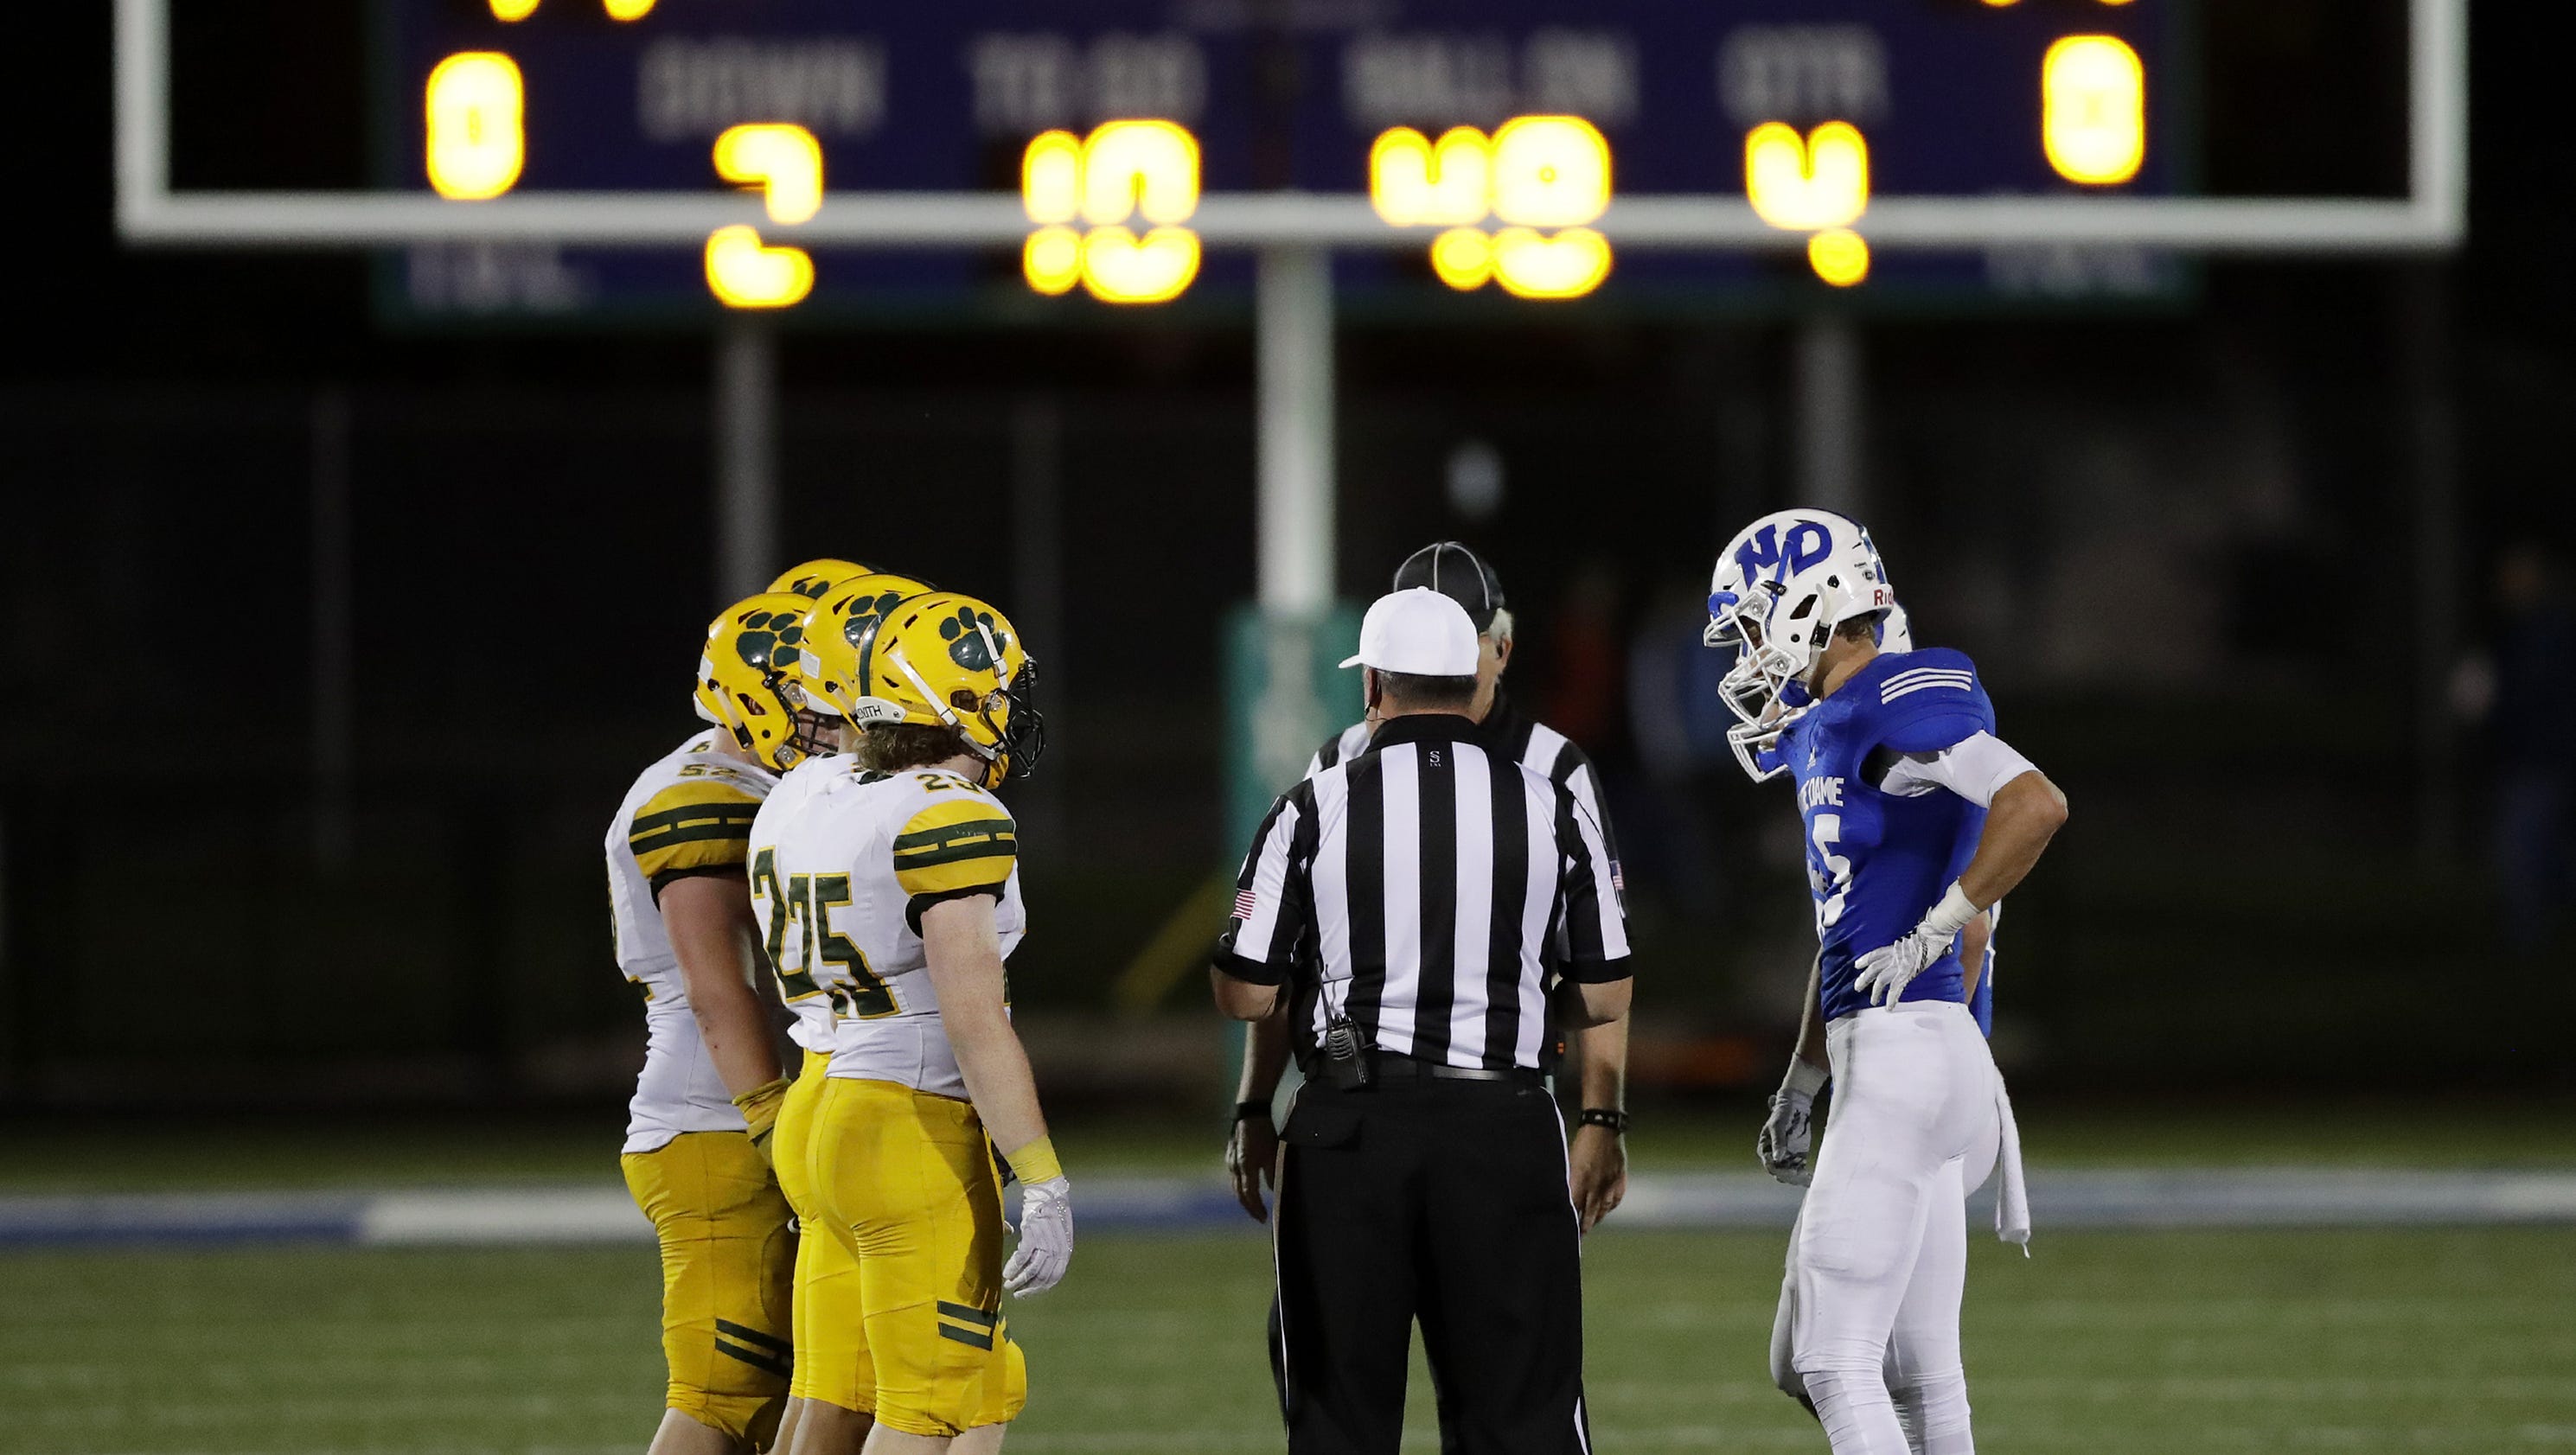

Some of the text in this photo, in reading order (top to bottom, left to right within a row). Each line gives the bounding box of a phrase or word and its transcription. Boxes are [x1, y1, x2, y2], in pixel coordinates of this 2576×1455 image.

[425, 50, 524, 200] 0
[2042, 34, 2144, 184] 0
[705, 123, 823, 309] 2
[1734, 522, 1832, 592] ND
